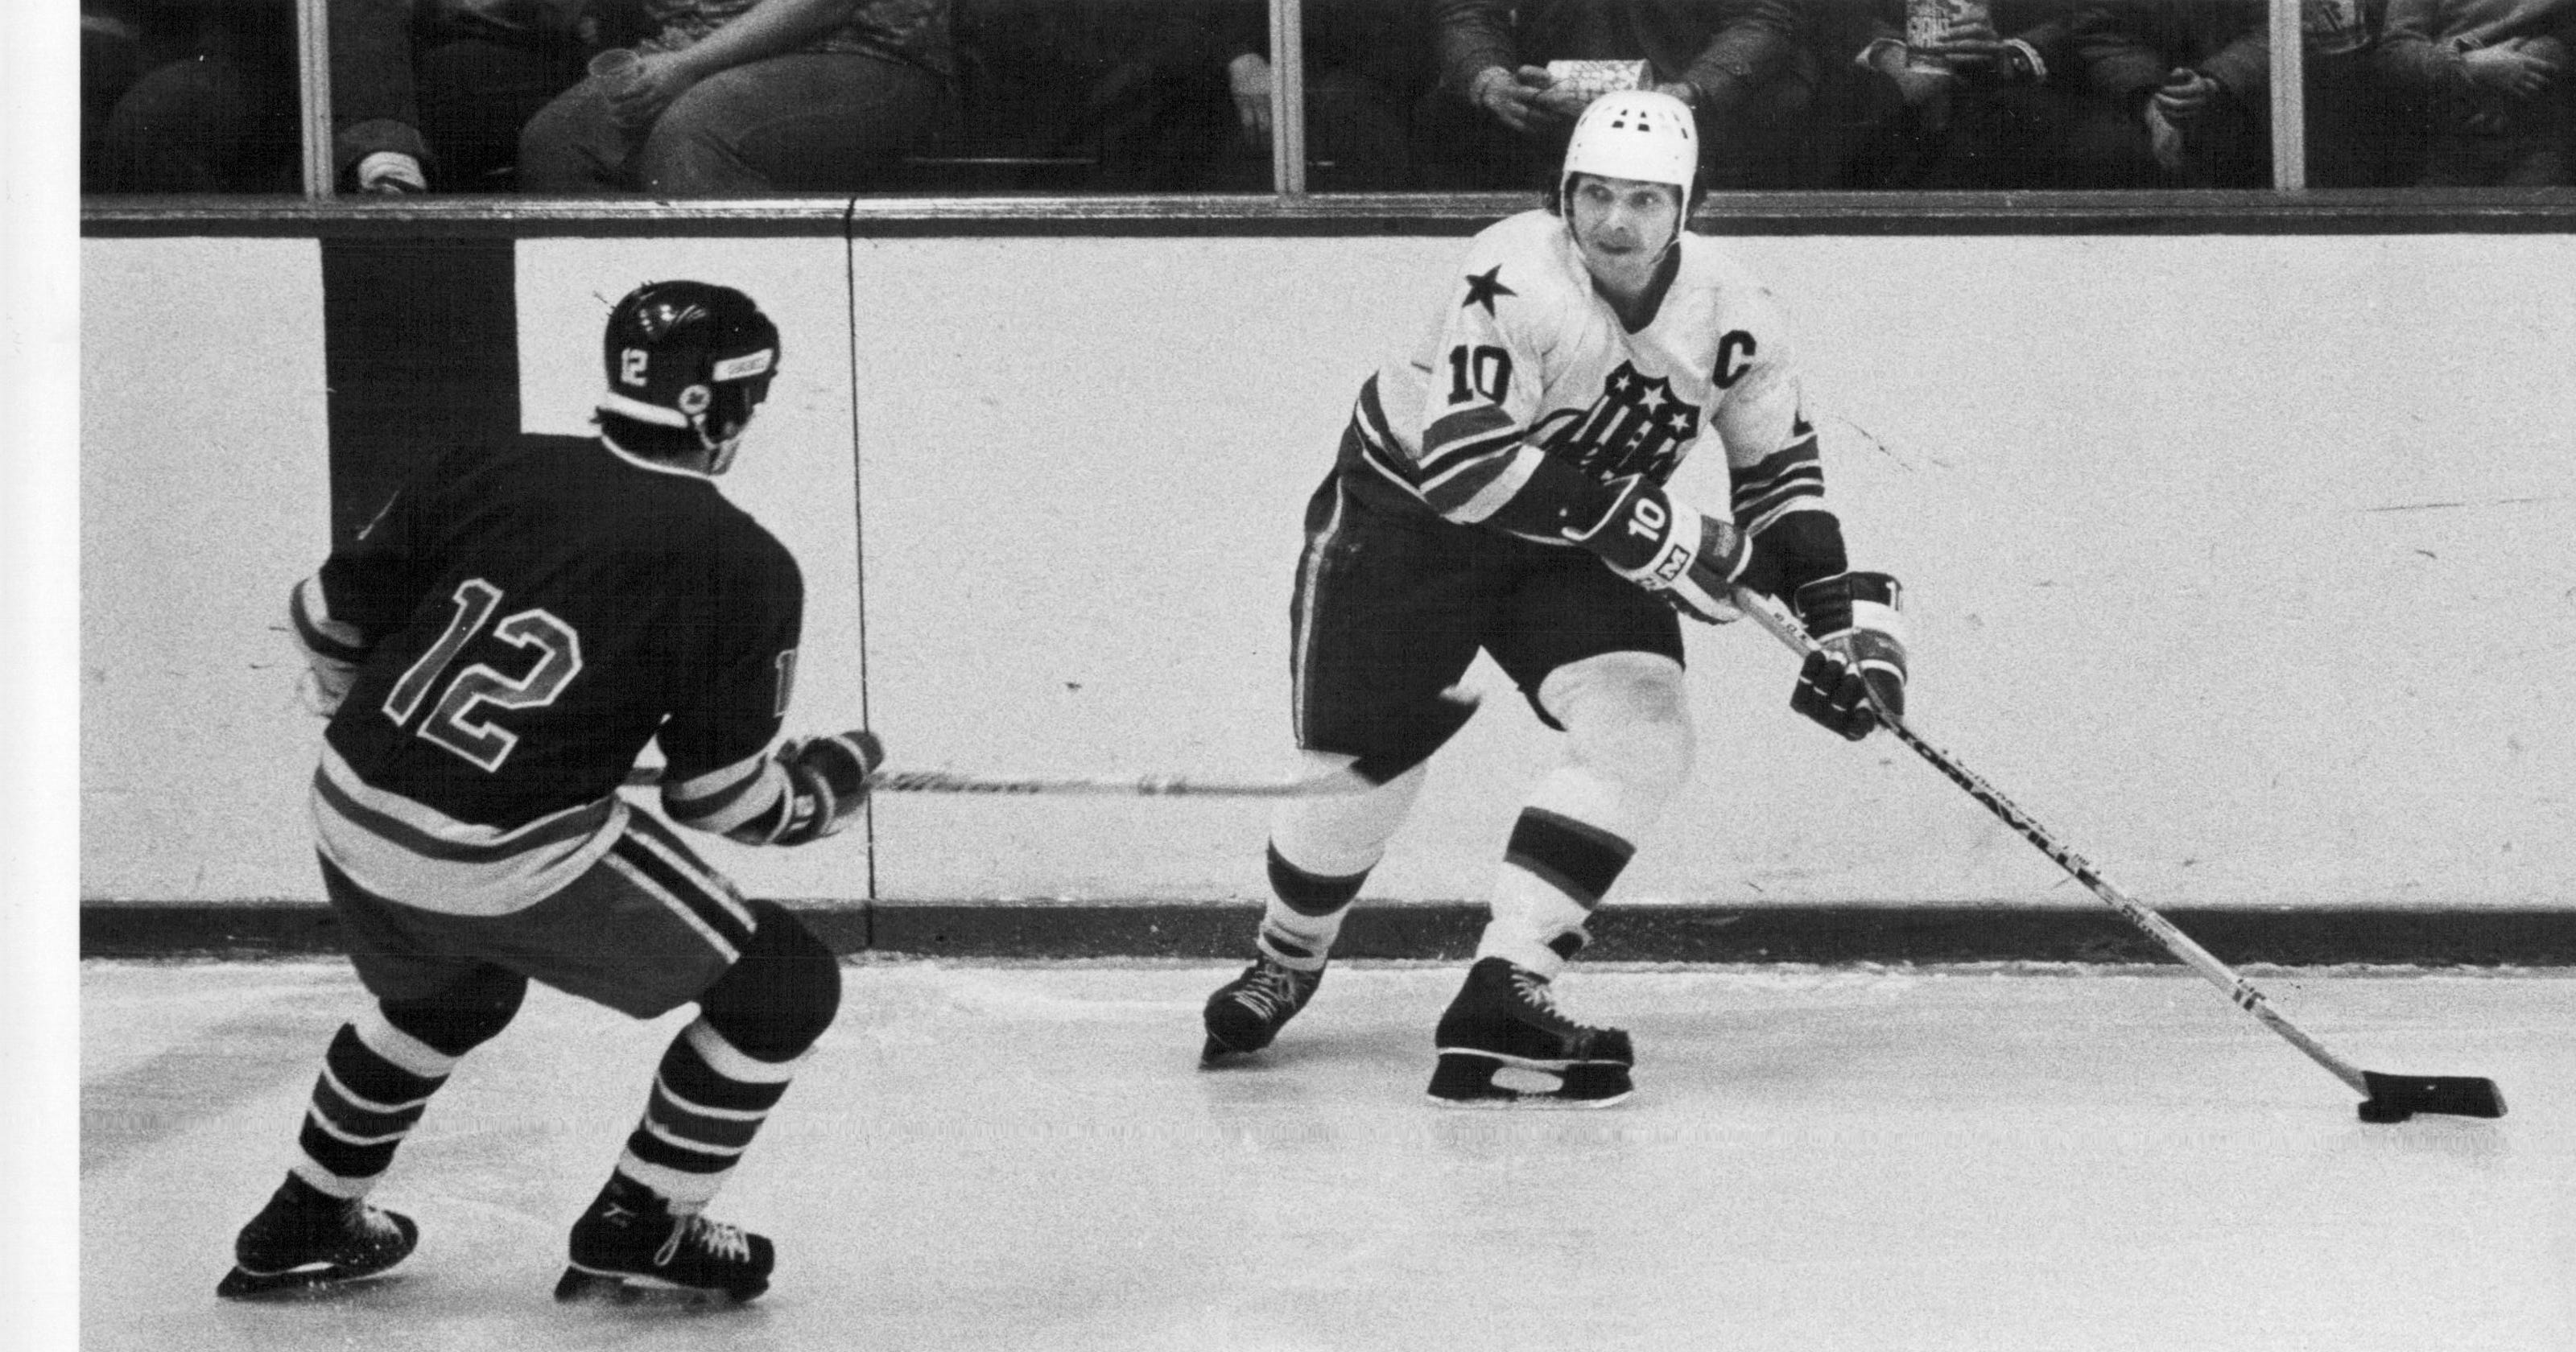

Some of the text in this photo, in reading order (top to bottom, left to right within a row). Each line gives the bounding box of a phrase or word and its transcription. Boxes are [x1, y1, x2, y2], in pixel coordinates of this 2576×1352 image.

[621, 347, 649, 387] 12
[1447, 344, 1513, 406] 10
[1711, 329, 1757, 390] C
[1628, 497, 1666, 542] 10
[382, 578, 584, 773] 12
